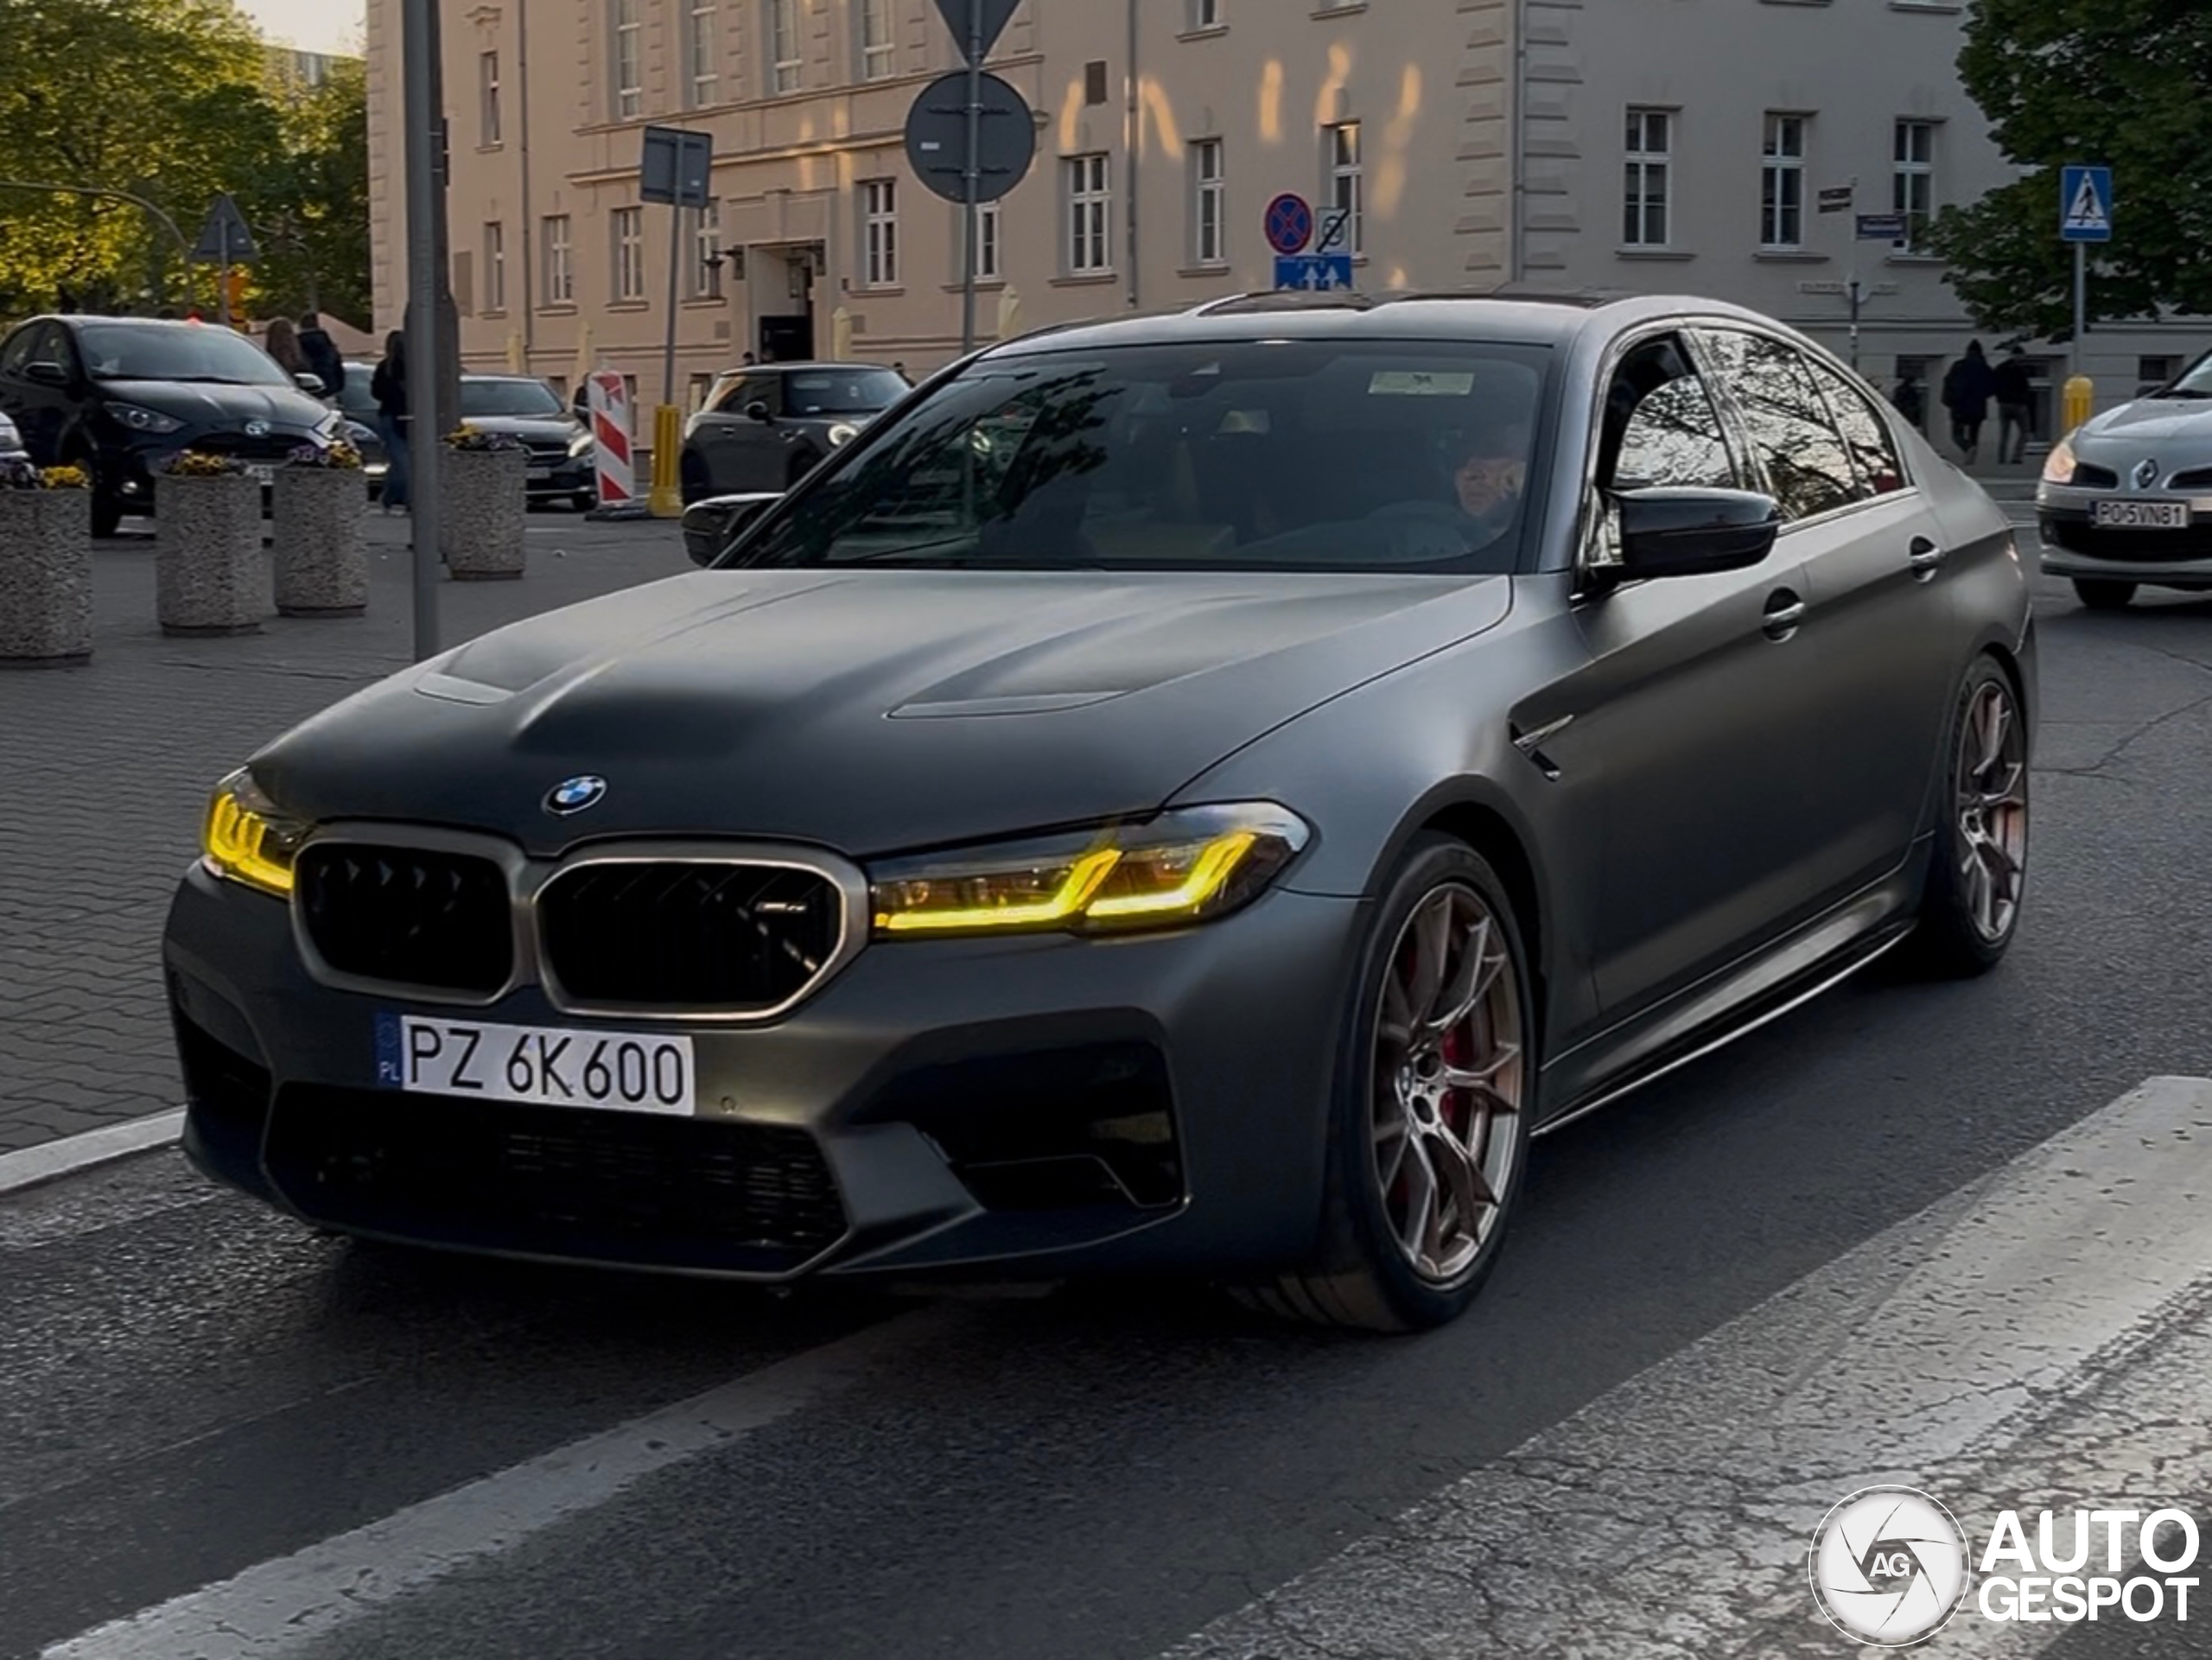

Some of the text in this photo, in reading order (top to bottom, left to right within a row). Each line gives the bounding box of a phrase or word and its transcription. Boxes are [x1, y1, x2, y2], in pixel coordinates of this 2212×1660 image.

[380, 1061, 401, 1081] PL
[409, 1025, 684, 1105] PZ 6K600
